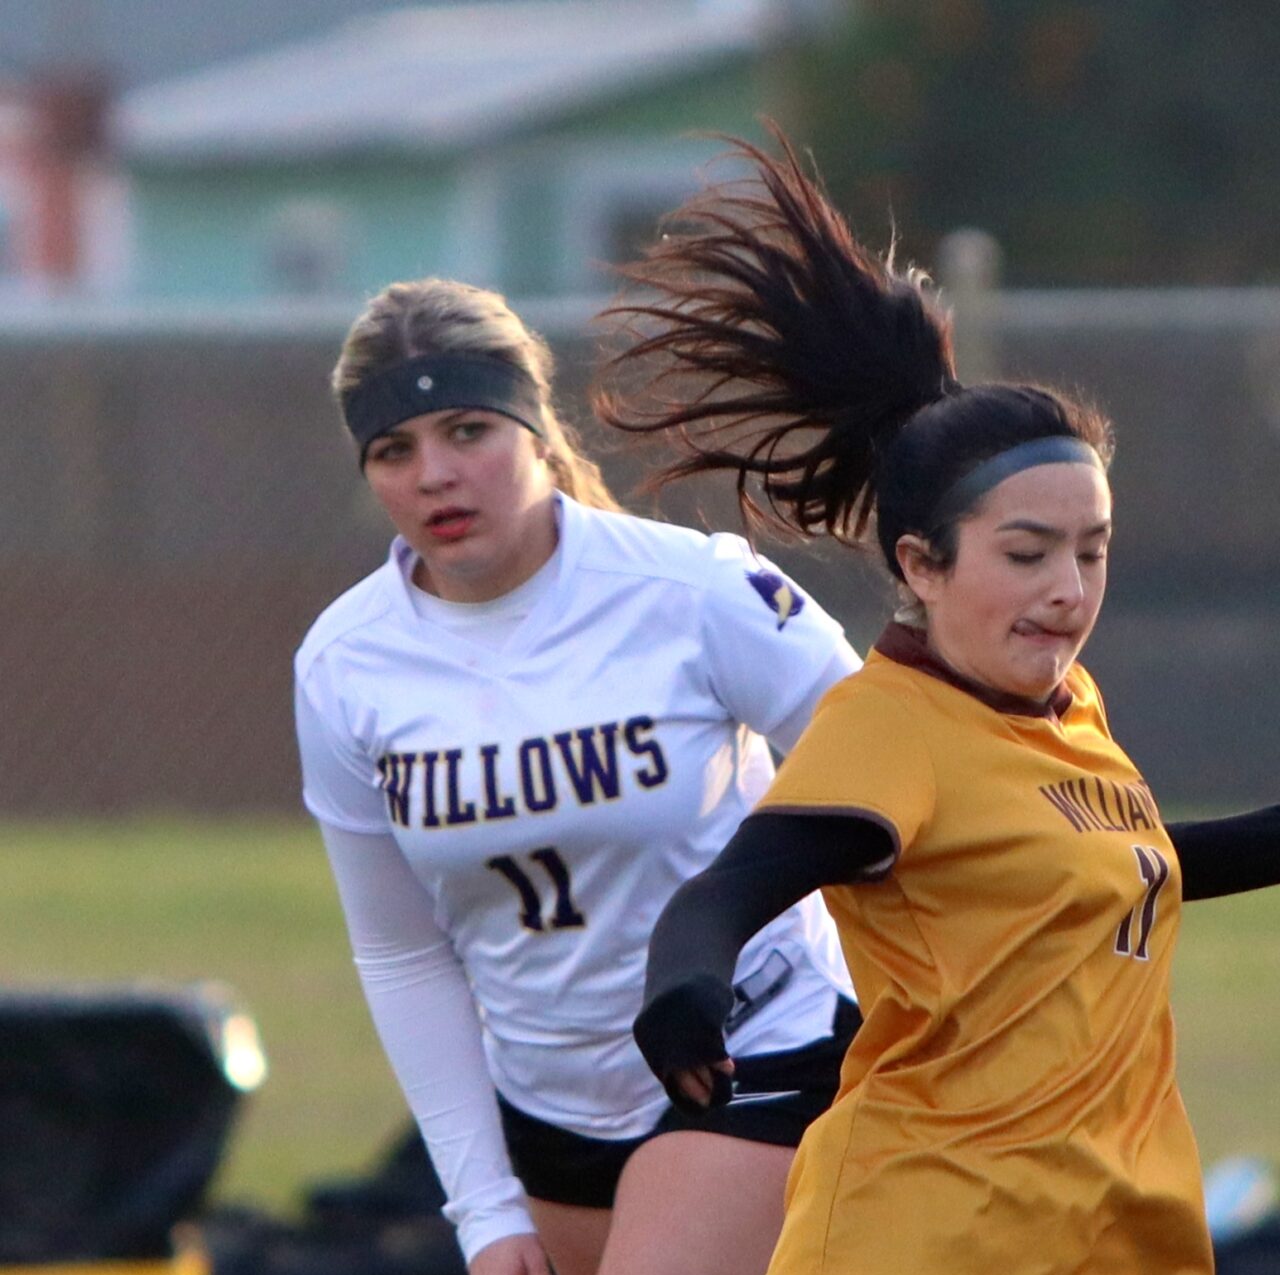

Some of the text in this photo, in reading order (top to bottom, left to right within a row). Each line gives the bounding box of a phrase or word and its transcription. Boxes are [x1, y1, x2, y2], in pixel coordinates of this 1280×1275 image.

[376, 714, 670, 829] WILLOWS
[484, 846, 587, 932] 11
[1113, 844, 1169, 961] 11
